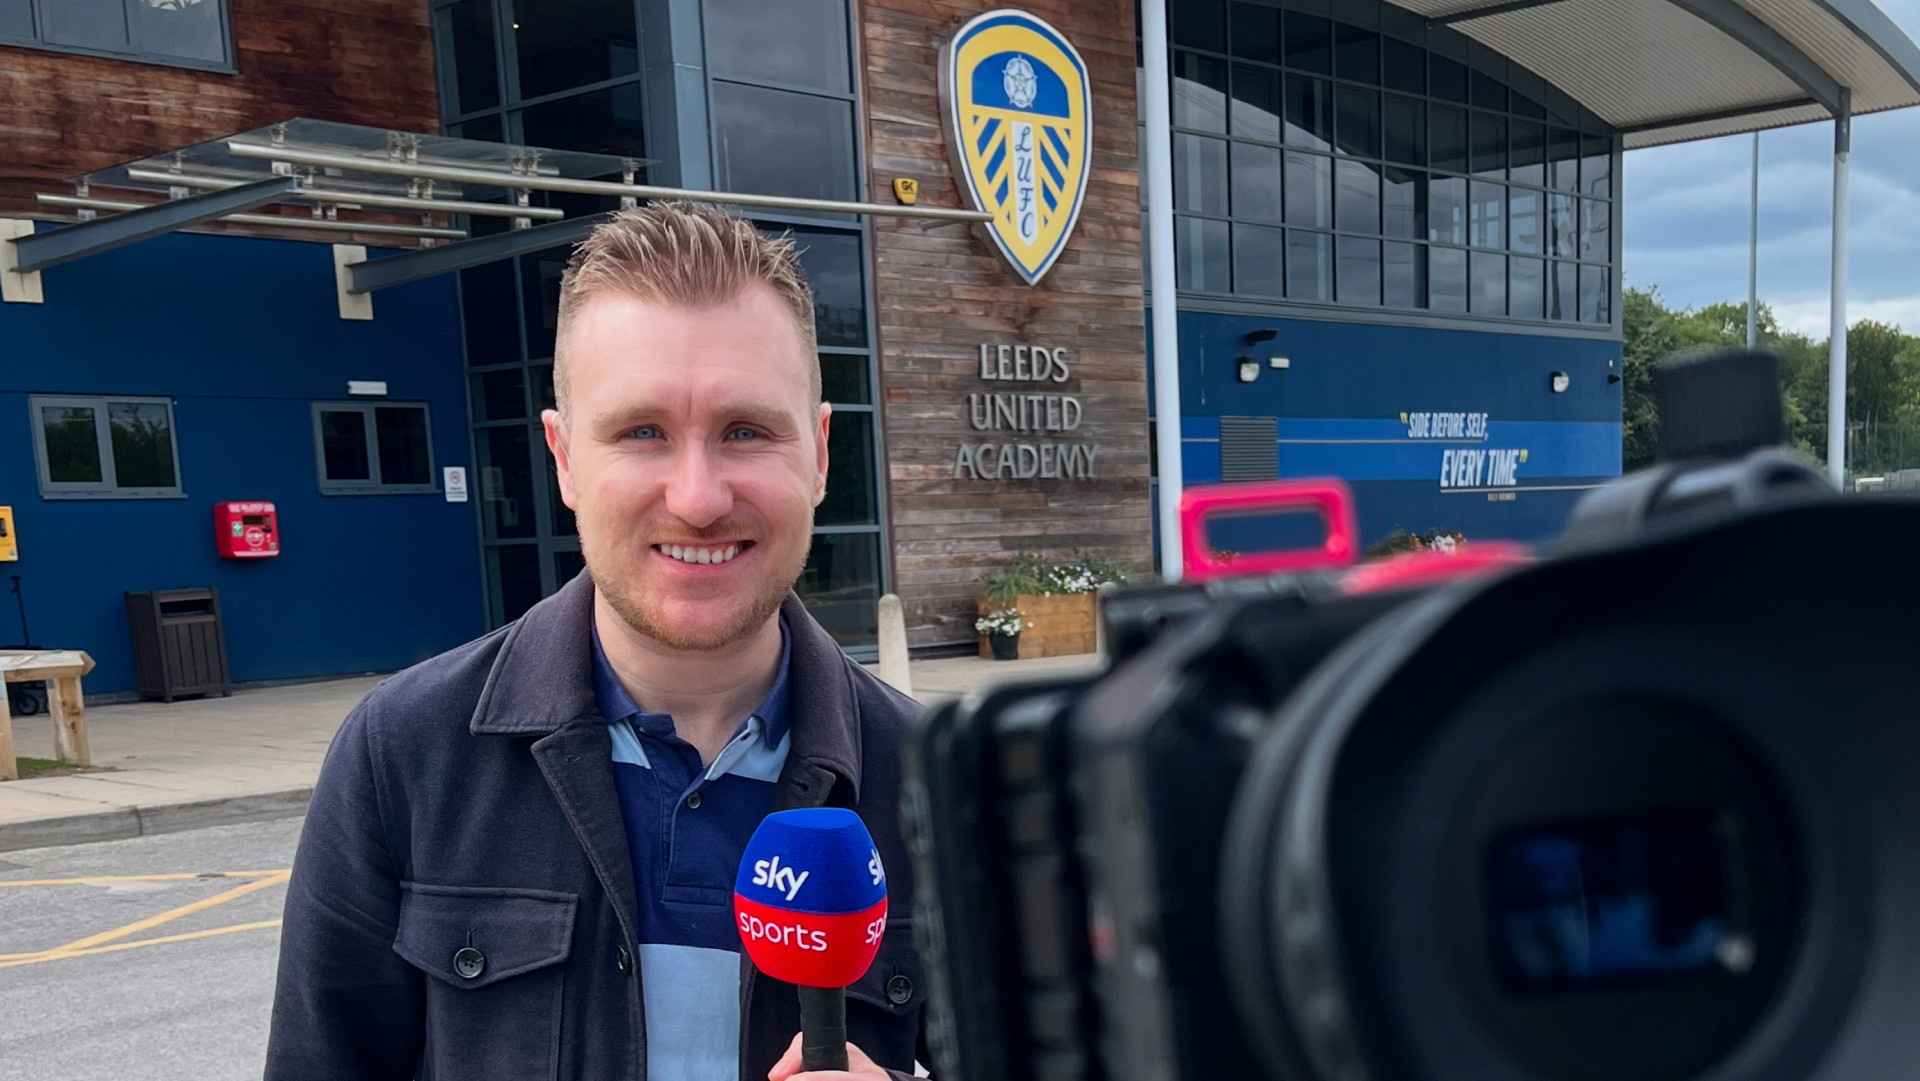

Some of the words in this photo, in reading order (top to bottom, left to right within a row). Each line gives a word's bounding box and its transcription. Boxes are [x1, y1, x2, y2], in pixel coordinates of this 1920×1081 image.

[980, 343, 1069, 383] LEEDS
[969, 393, 1082, 431] UNITED
[1431, 413, 1466, 438] BEFORE
[1466, 412, 1489, 441] SELF,
[953, 443, 1099, 480] ACADEMY
[1440, 449, 1486, 487] EVERY
[752, 855, 810, 901] sky
[739, 912, 828, 952] sports
